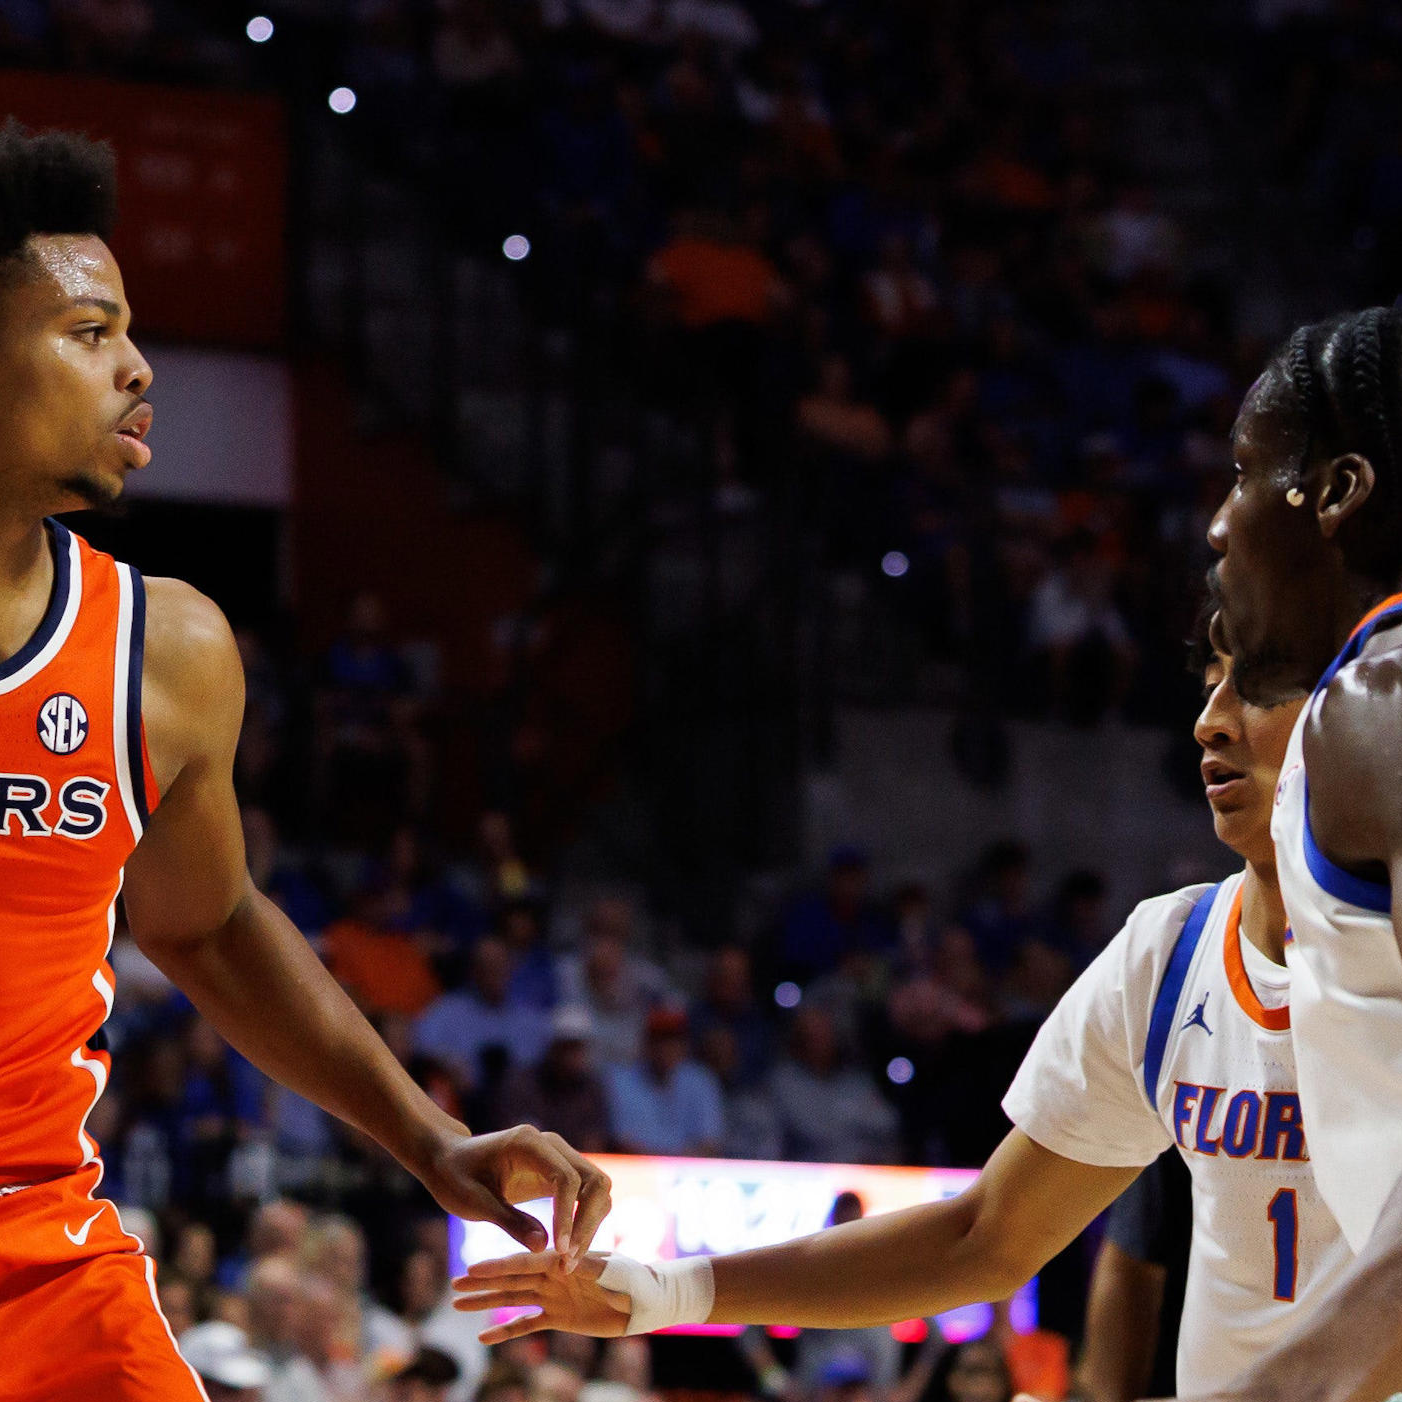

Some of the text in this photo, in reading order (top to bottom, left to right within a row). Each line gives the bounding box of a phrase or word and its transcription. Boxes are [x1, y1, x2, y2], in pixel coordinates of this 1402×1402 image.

[38, 695, 88, 754] SEC
[1173, 1080, 1311, 1163] FLOR
[1267, 1187, 1298, 1303] 1
